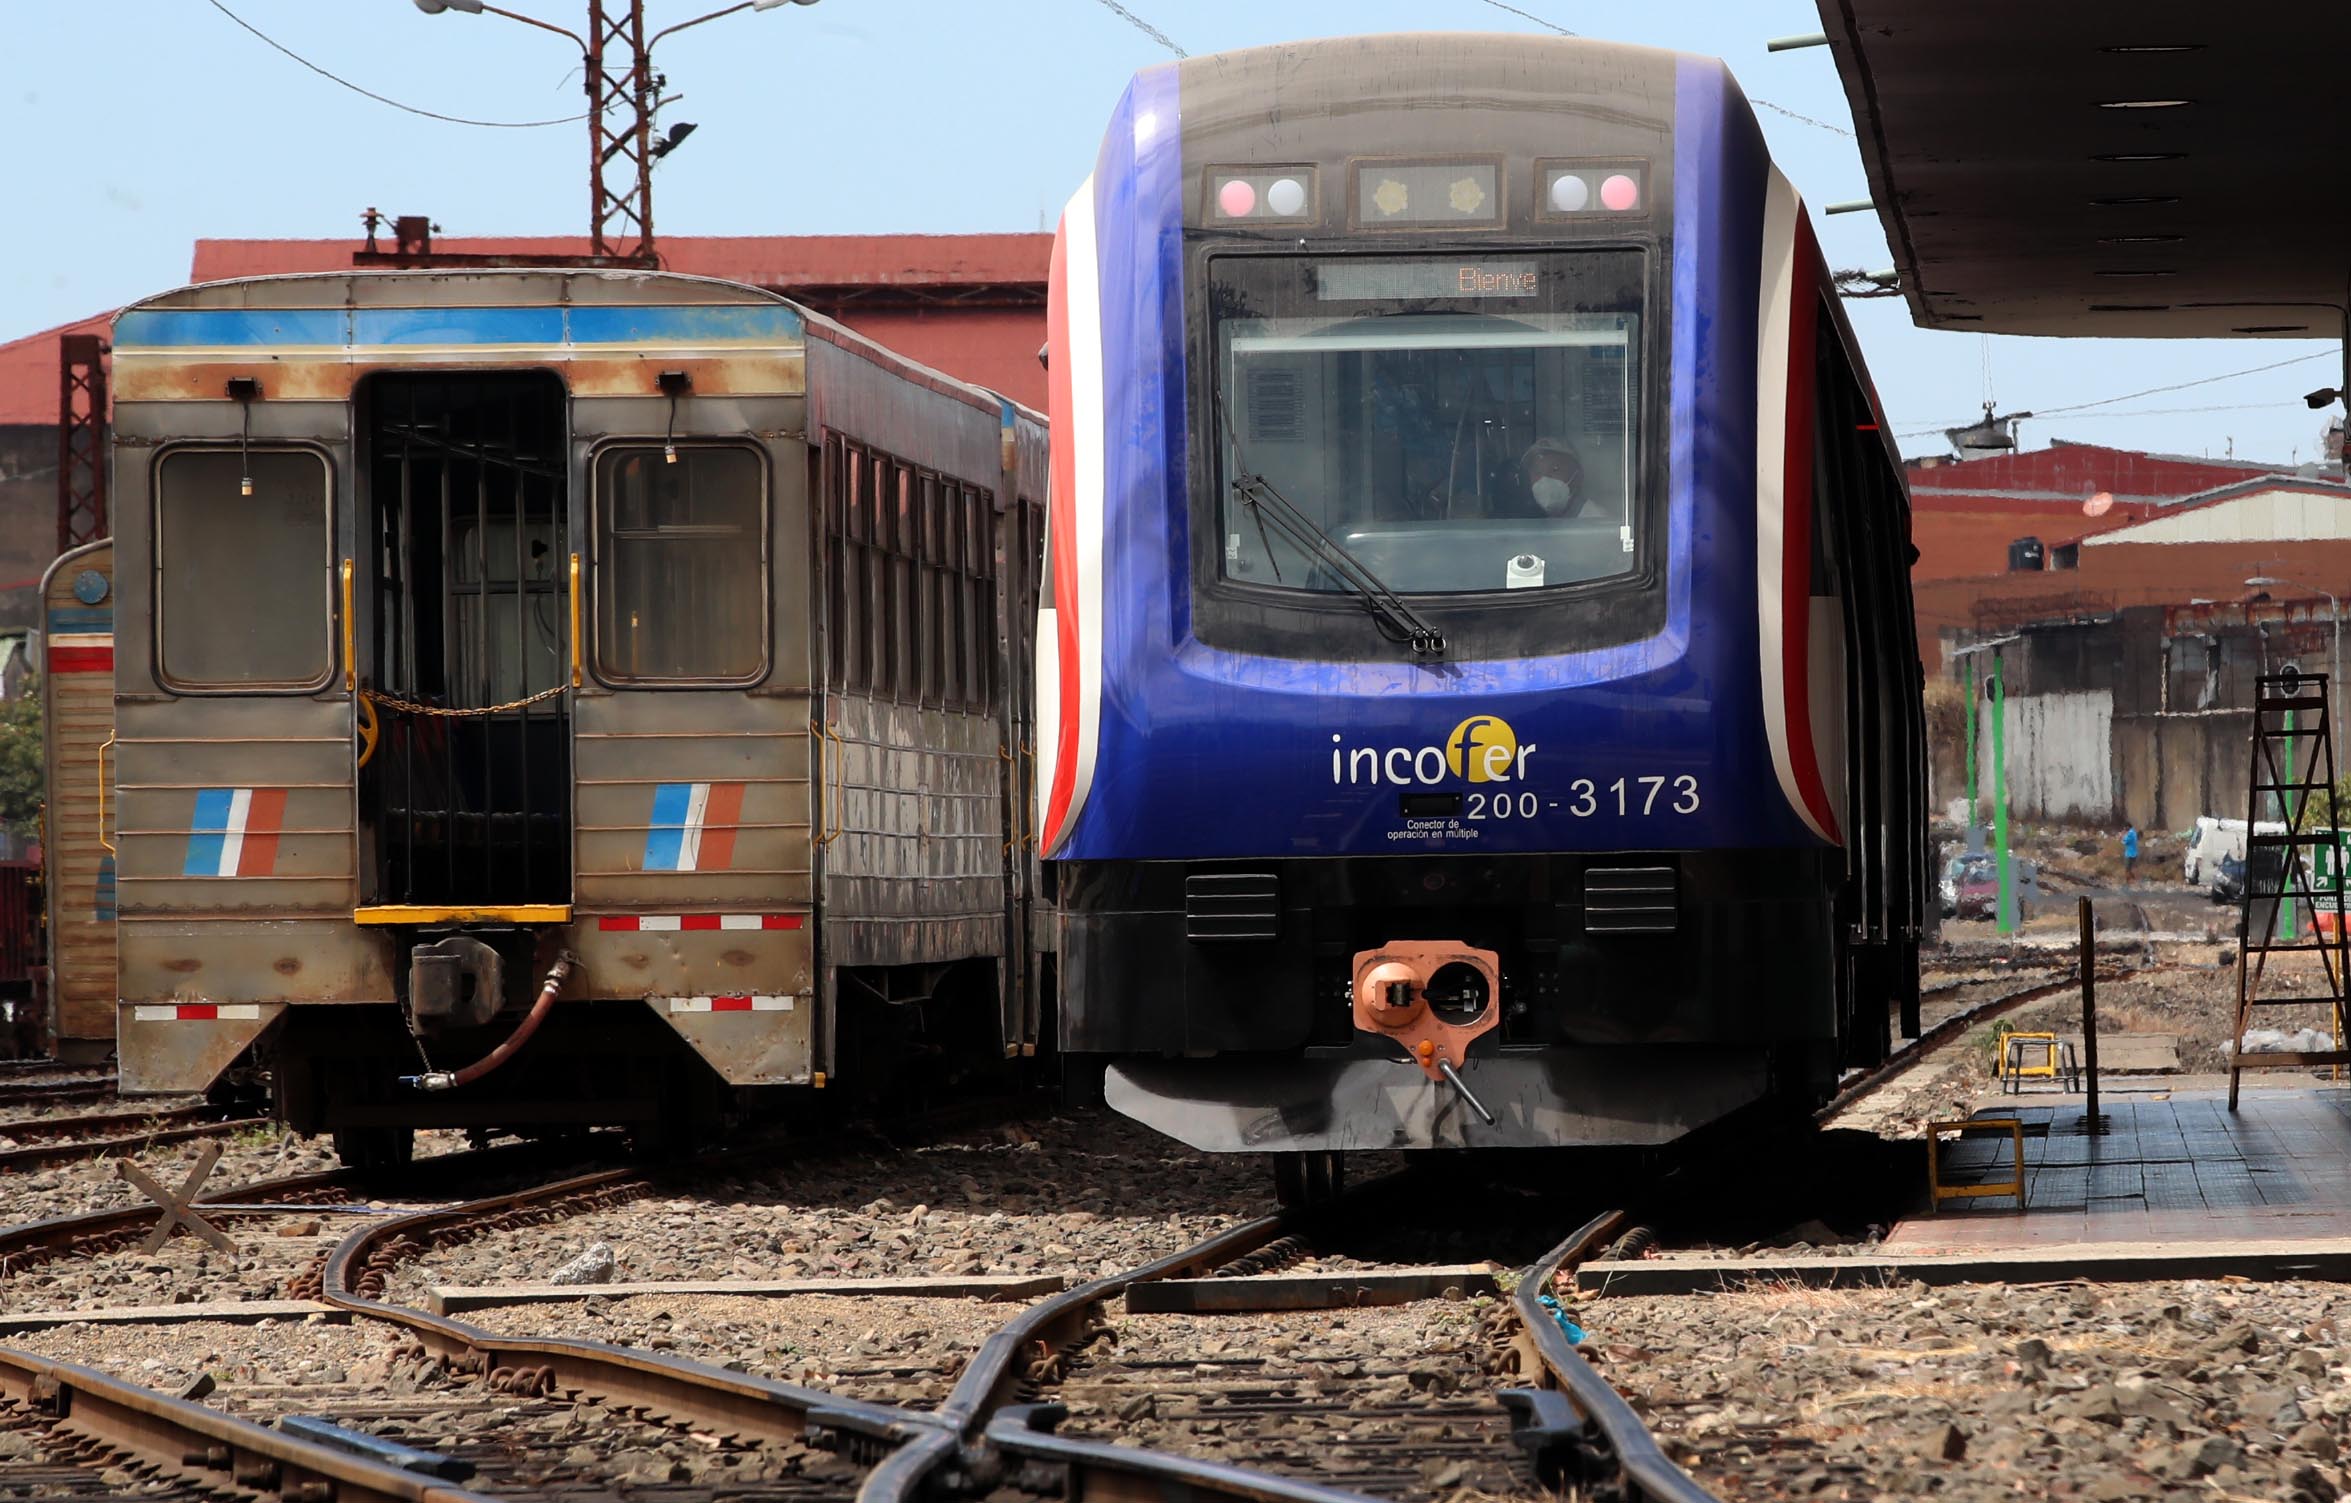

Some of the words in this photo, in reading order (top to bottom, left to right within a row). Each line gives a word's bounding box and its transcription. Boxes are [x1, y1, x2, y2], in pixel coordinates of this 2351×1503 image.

[1458, 266, 1536, 291] Bienve
[1332, 719, 1537, 785] incofer
[1406, 819, 1446, 830] Conector
[1448, 818, 1460, 829] de
[1387, 829, 1429, 841] operación
[1431, 830, 1443, 839] en
[1445, 828, 1479, 840] múltiple
